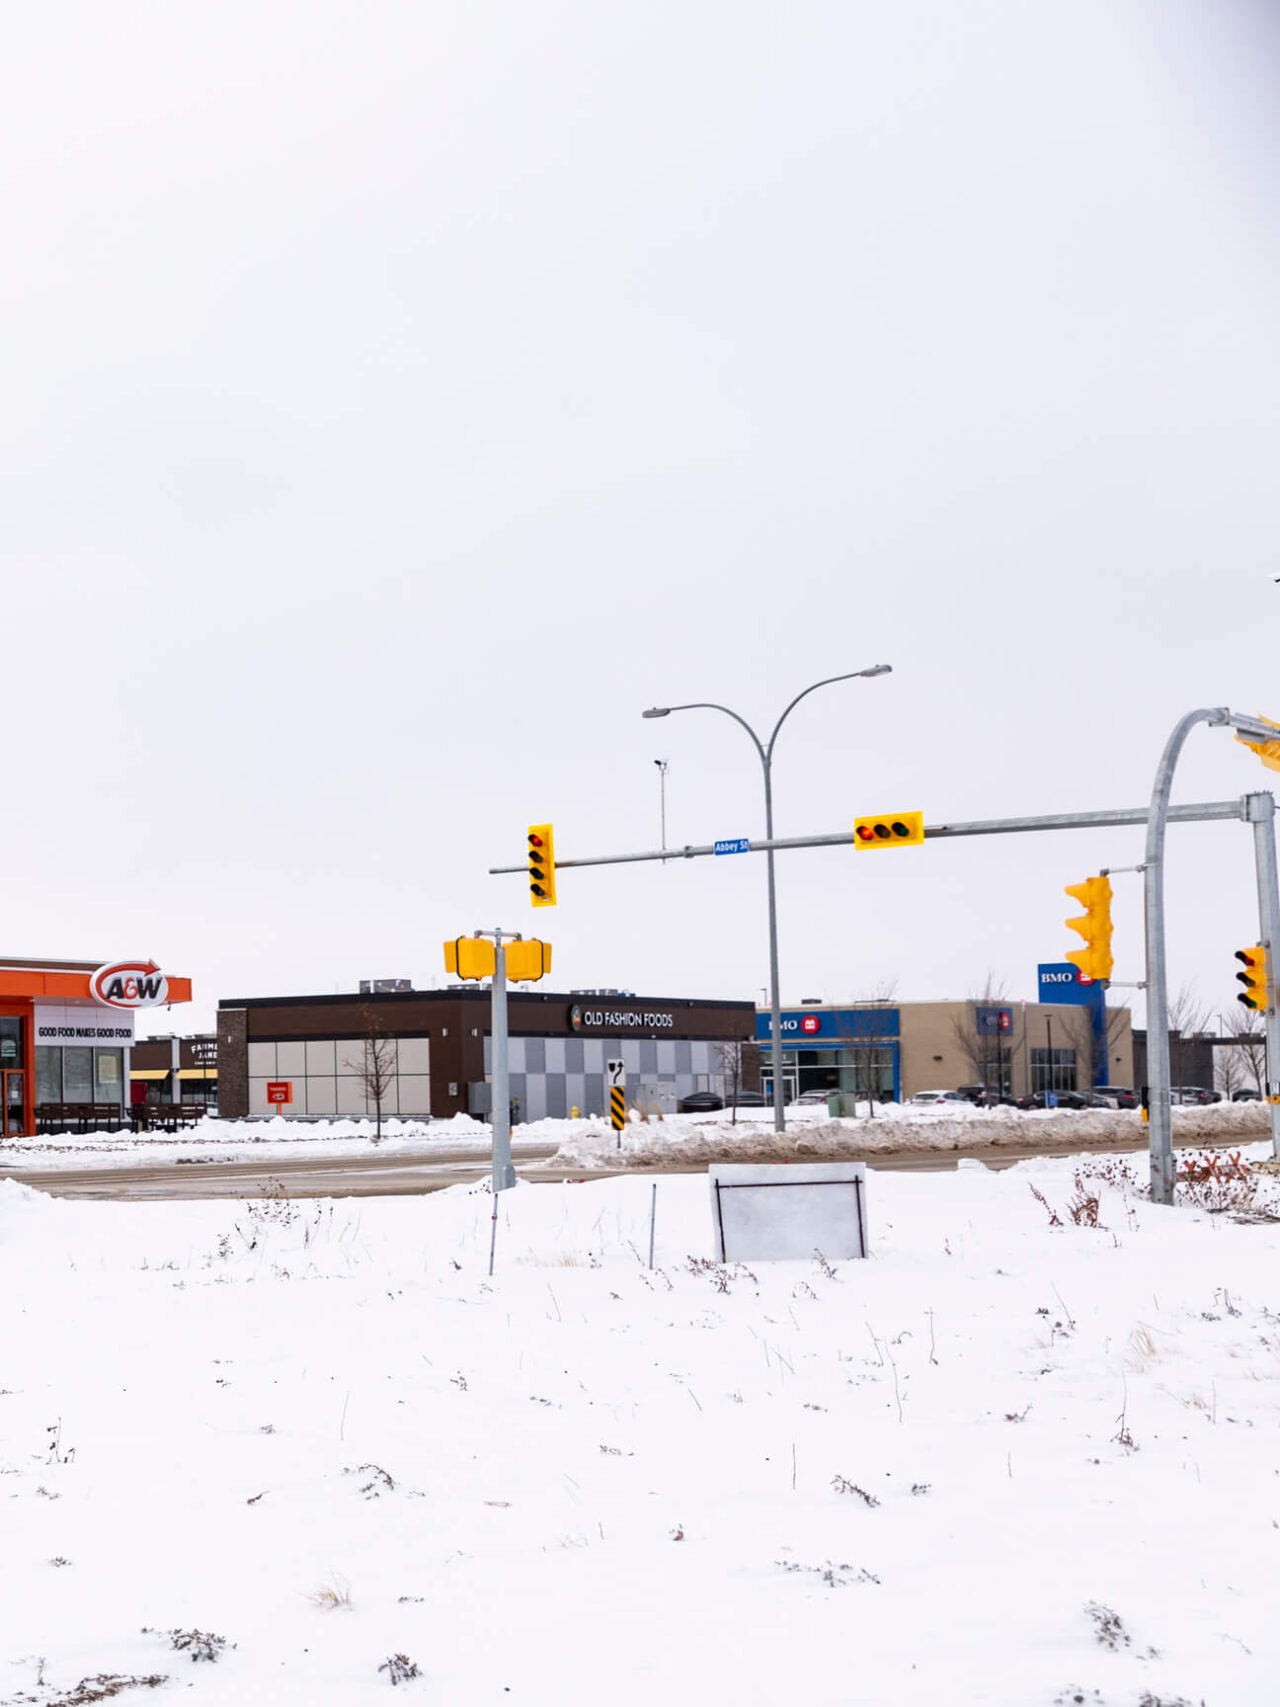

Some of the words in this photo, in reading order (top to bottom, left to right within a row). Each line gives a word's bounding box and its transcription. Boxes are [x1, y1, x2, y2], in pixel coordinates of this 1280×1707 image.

[716, 843, 738, 852] Abbey
[740, 840, 748, 850] St
[1041, 972, 1072, 983] BMO
[105, 976, 163, 1000] A&W
[584, 1011, 603, 1026] OLD
[605, 1011, 642, 1026] FASHION
[644, 1013, 673, 1027] FOODS
[768, 1020, 798, 1031] MO
[38, 1027, 57, 1038] GOOD
[58, 1027, 75, 1038] FOOD
[76, 1027, 96, 1038] MAKES
[97, 1027, 114, 1038] GOOD
[115, 1028, 132, 1039] FOOD
